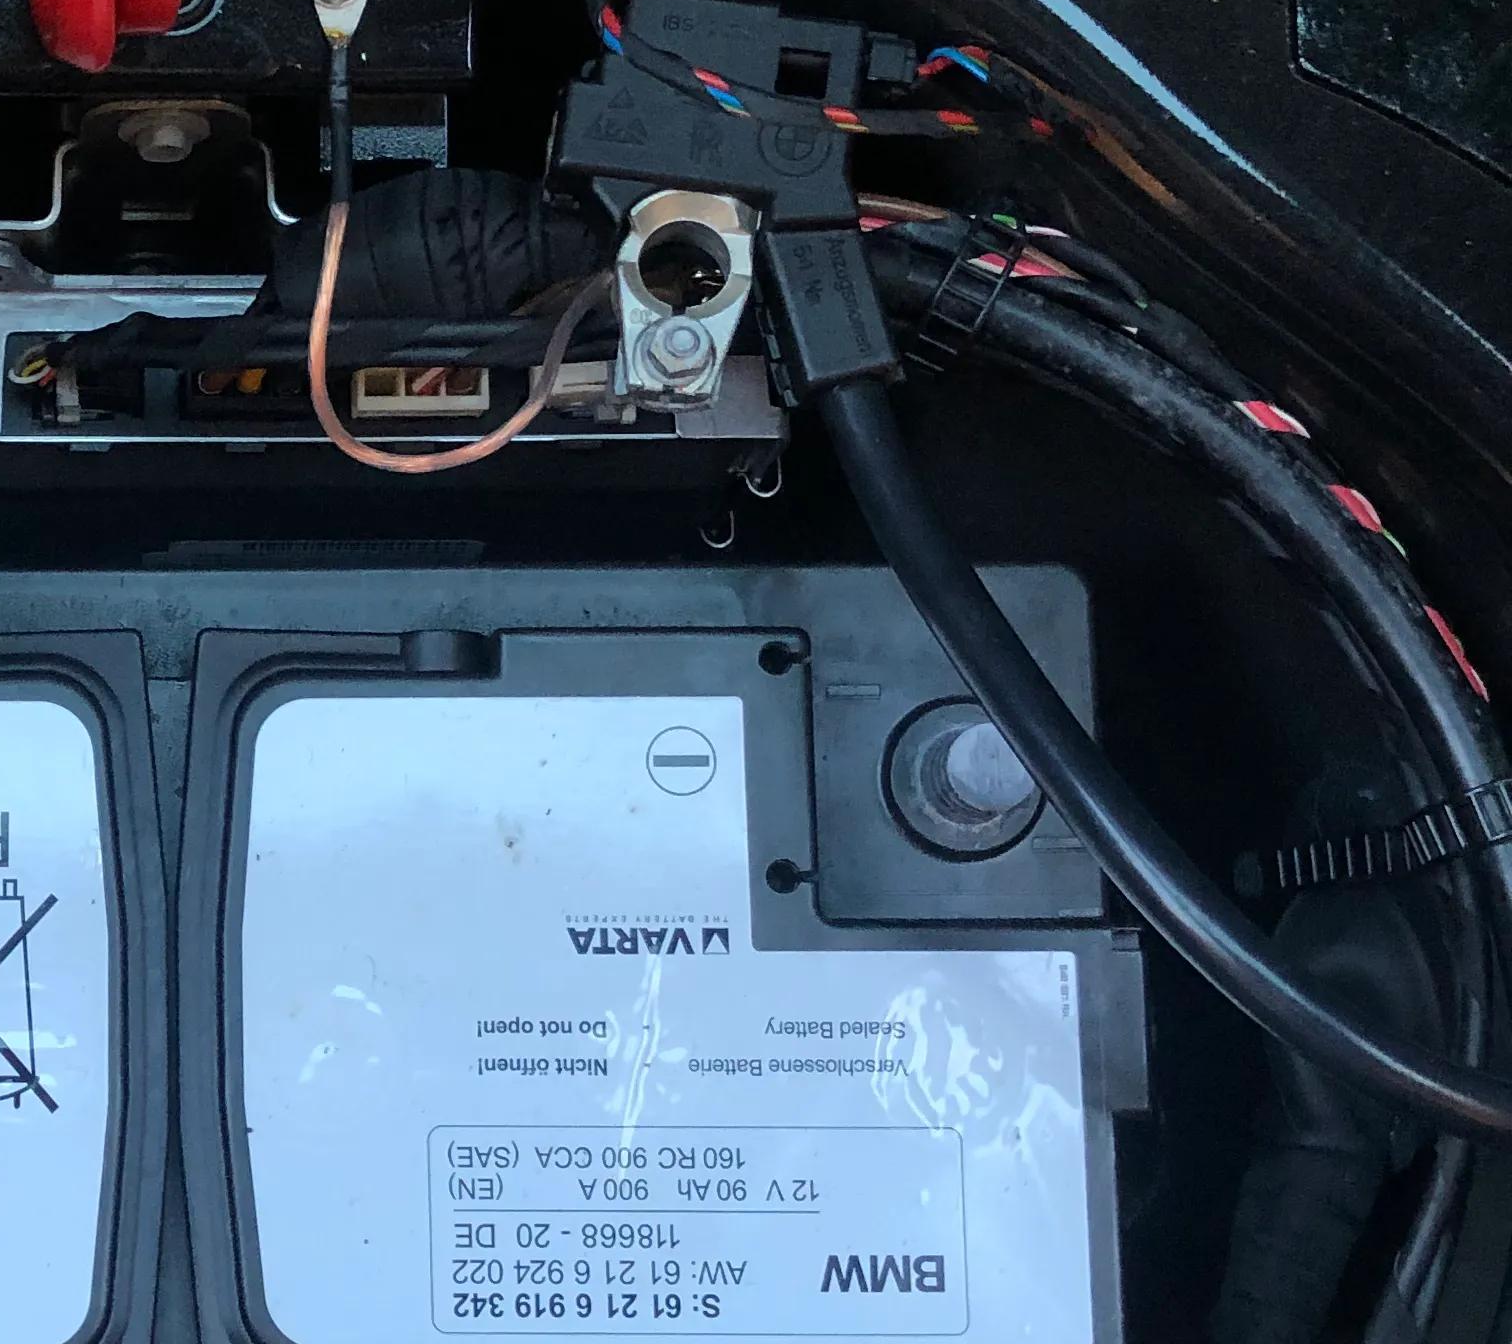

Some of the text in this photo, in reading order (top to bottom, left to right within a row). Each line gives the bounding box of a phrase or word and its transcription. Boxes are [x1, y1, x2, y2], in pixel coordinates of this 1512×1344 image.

[566, 915, 728, 923] THE BATTERY EXPERTS
[567, 928, 694, 954] VARTA
[478, 1017, 533, 1037] open!
[540, 1019, 573, 1035] not
[579, 1021, 606, 1037] Do
[765, 1017, 833, 1039] Battery
[840, 1021, 905, 1039] Sealed
[479, 1058, 549, 1075] öffnen!
[555, 1059, 607, 1076] Nicht
[689, 1059, 762, 1076] Batterie
[769, 1059, 907, 1076] Verschlossene
[448, 1141, 745, 1169] 160 RC 900 CCA (SAE)
[449, 1173, 819, 1201] 12 V 90 Ah 900 A (EN)
[455, 1224, 495, 1248] DE
[517, 1223, 549, 1248] 20
[582, 1224, 680, 1248] 118668
[453, 1259, 747, 1285] AW: 61 21 6 924 022
[821, 1255, 945, 1292] BMW
[454, 1293, 720, 1318] S: 61 21 6 919 342
